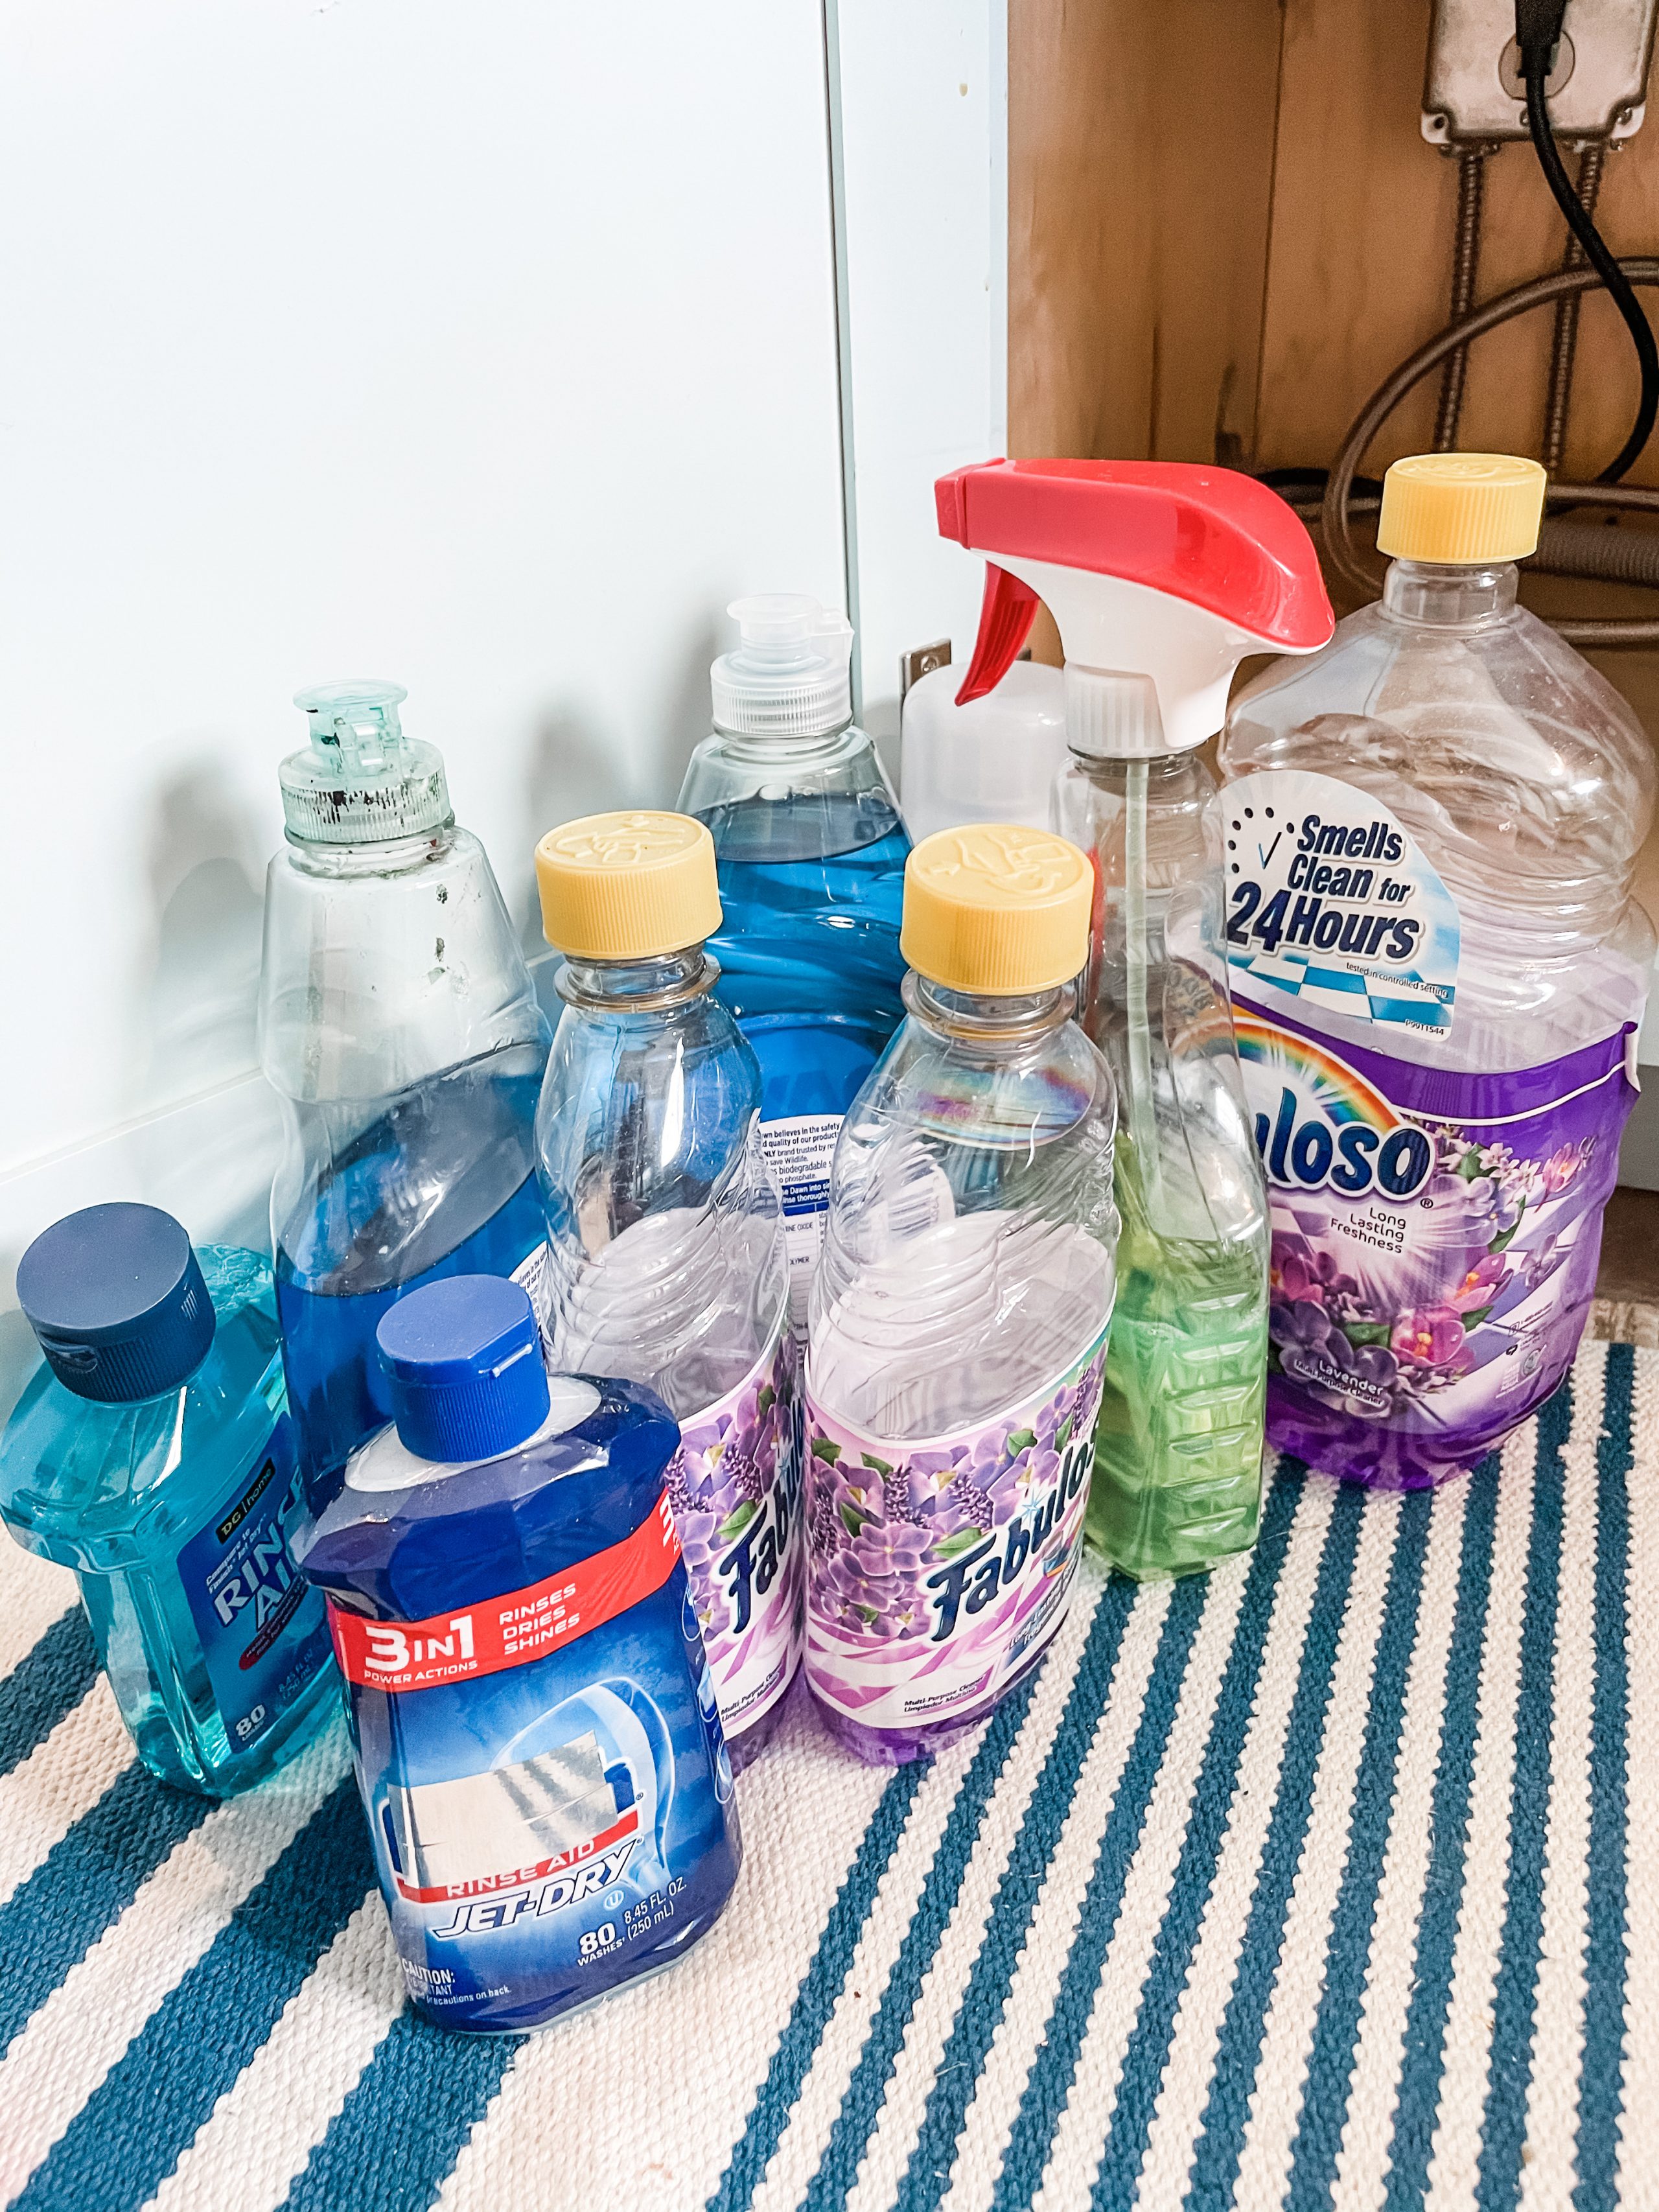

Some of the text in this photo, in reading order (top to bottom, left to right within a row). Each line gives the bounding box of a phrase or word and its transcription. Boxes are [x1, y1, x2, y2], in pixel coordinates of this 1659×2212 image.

[1297, 814, 1402, 861] Smells
[1287, 853, 1411, 902] Clean for
[1347, 962, 1448, 999] tested in controlled setting
[769, 1137, 791, 1148] quality
[812, 1132, 838, 1143] product
[774, 1129, 801, 1138] believes
[820, 1123, 841, 1131] safety
[1255, 1086, 1431, 1195] loso
[777, 1148, 796, 1157] brand
[796, 1145, 818, 1154] trusted
[779, 1159, 828, 1175] biodegradable
[790, 1186, 809, 1194] Dawn
[809, 1184, 822, 1193] into
[1330, 1217, 1402, 1253] Freshness
[1350, 1213, 1404, 1242] Lasting
[1370, 1207, 1406, 1229] Long
[1319, 1360, 1384, 1395] Lavender
[220, 1511, 241, 1535] DG
[499, 1583, 576, 1625] RINSES
[503, 1605, 566, 1640] DRIES
[504, 1612, 581, 1655] SHINES
[364, 1660, 478, 1684] POWER ACTIONS
[236, 1705, 266, 1736] 80
[447, 1839, 596, 1898] RINSE AID
[432, 1838, 636, 1938] JET-DRY
[624, 1876, 688, 1924] 8.45 FL. OZ.
[627, 1900, 675, 1941] (250 mL)
[579, 1922, 616, 1955] 80
[401, 1957, 456, 1985] CAUTION:
[476, 1991, 487, 2000] on
